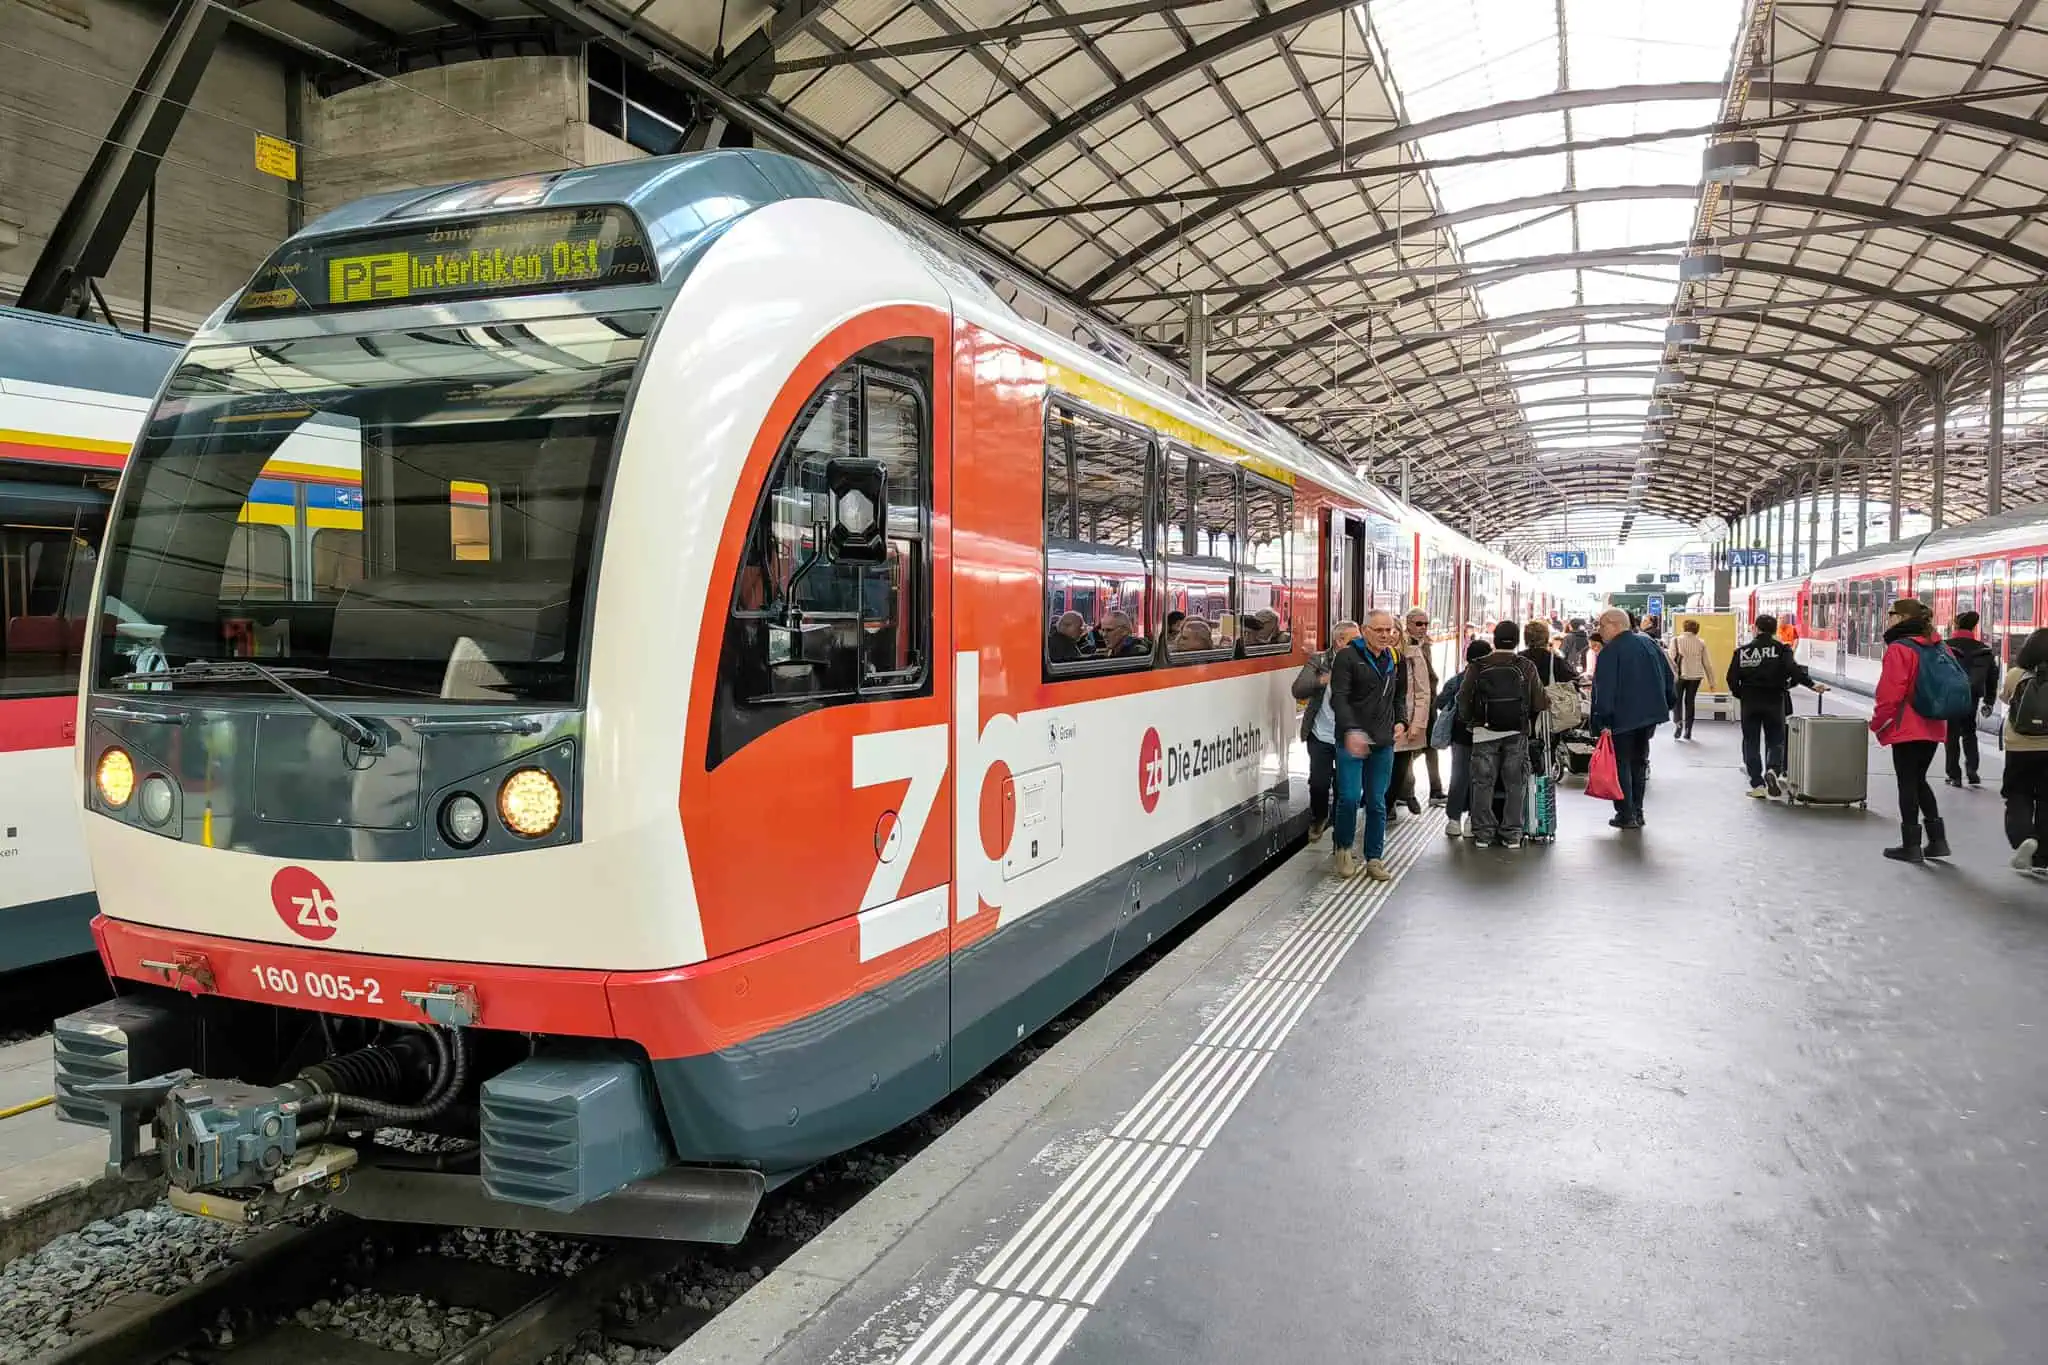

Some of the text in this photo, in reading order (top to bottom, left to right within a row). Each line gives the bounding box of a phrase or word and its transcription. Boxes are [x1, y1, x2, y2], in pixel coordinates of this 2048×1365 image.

[343, 260, 394, 301] PE
[412, 248, 543, 288] Interlaken
[553, 239, 598, 276] Ost
[1571, 557, 1580, 568] A
[1733, 554, 1766, 564] A 12
[1740, 645, 1779, 660] KARL
[1167, 743, 1190, 787] Die
[291, 888, 340, 928] zb
[251, 963, 384, 1004] 160 005-2
